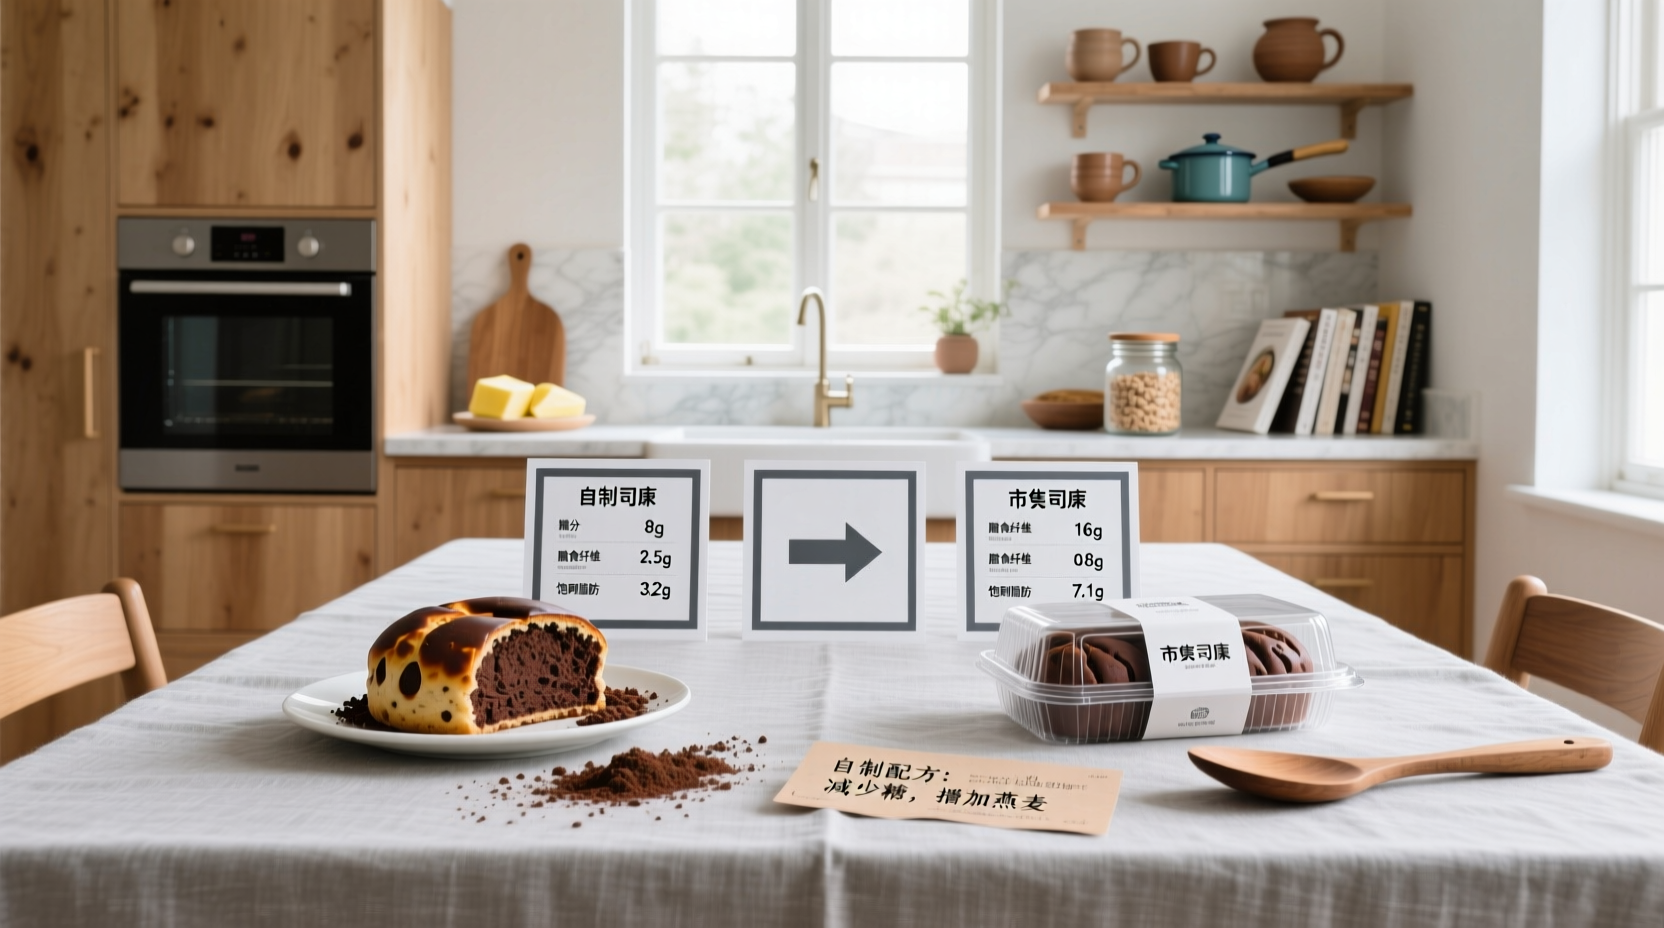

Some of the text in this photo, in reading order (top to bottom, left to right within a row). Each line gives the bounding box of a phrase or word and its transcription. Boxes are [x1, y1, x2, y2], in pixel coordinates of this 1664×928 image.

[580, 486, 657, 507] 自制司康
[644, 519, 664, 538] 8g
[1075, 522, 1103, 541] 16g
[640, 549, 672, 569] 2.5g
[1073, 552, 1104, 571] 08g
[1072, 583, 1104, 601] 7.1g
